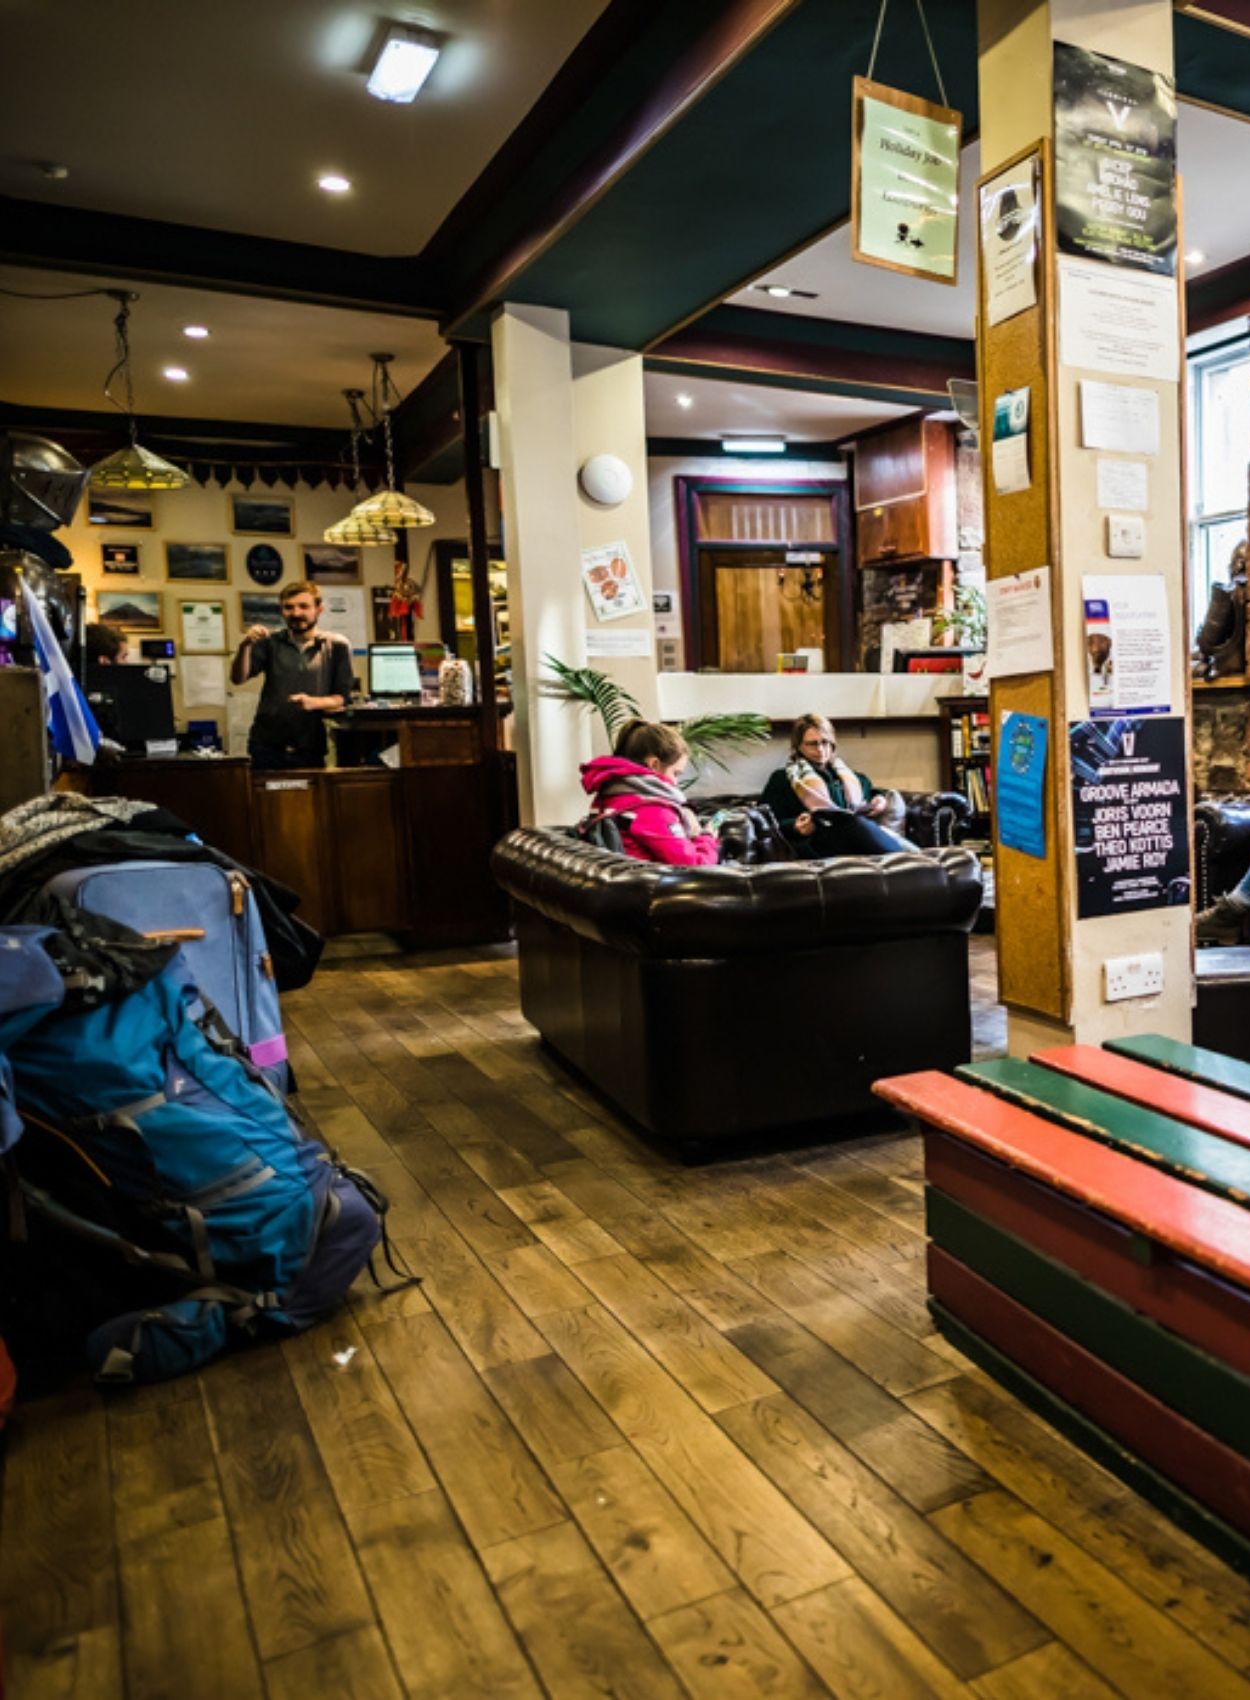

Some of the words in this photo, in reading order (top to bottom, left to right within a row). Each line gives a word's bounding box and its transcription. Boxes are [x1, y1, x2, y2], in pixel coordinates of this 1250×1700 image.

[1079, 783, 1128, 803] GROOVE
[1131, 779, 1180, 800] ARMADA
[1092, 804, 1129, 824] JORIS
[1131, 801, 1172, 820] VOORN
[1094, 823, 1120, 840] BEN
[1123, 818, 1170, 837] PEARCE
[1093, 839, 1127, 858] THEO
[1103, 854, 1141, 873] JAMIE
[1143, 851, 1168, 869] ROY
